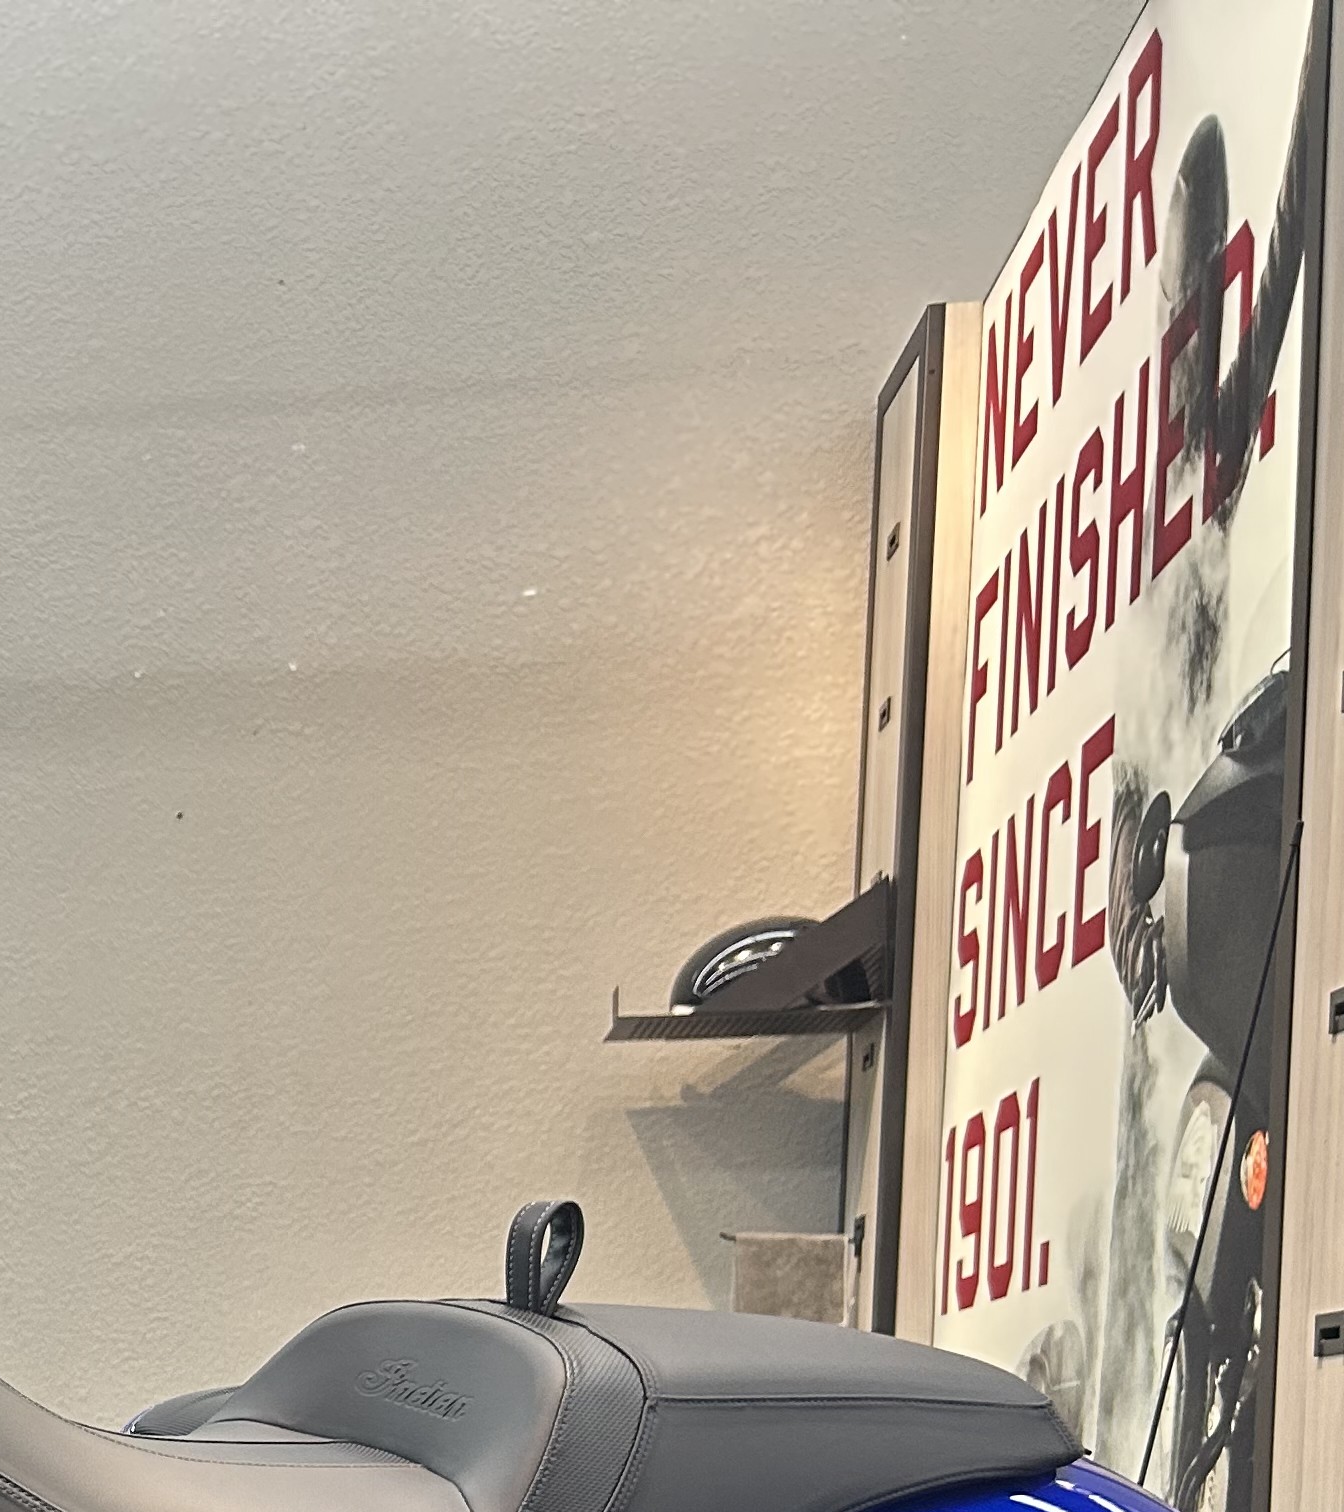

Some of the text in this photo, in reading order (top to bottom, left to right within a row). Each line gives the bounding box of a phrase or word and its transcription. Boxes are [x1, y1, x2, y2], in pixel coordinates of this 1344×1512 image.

[980, 28, 1162, 518] NEVER
[954, 714, 1115, 1049] SINCE
[940, 1077, 1050, 1316] 1901.
[355, 1357, 474, 1423] Indian
